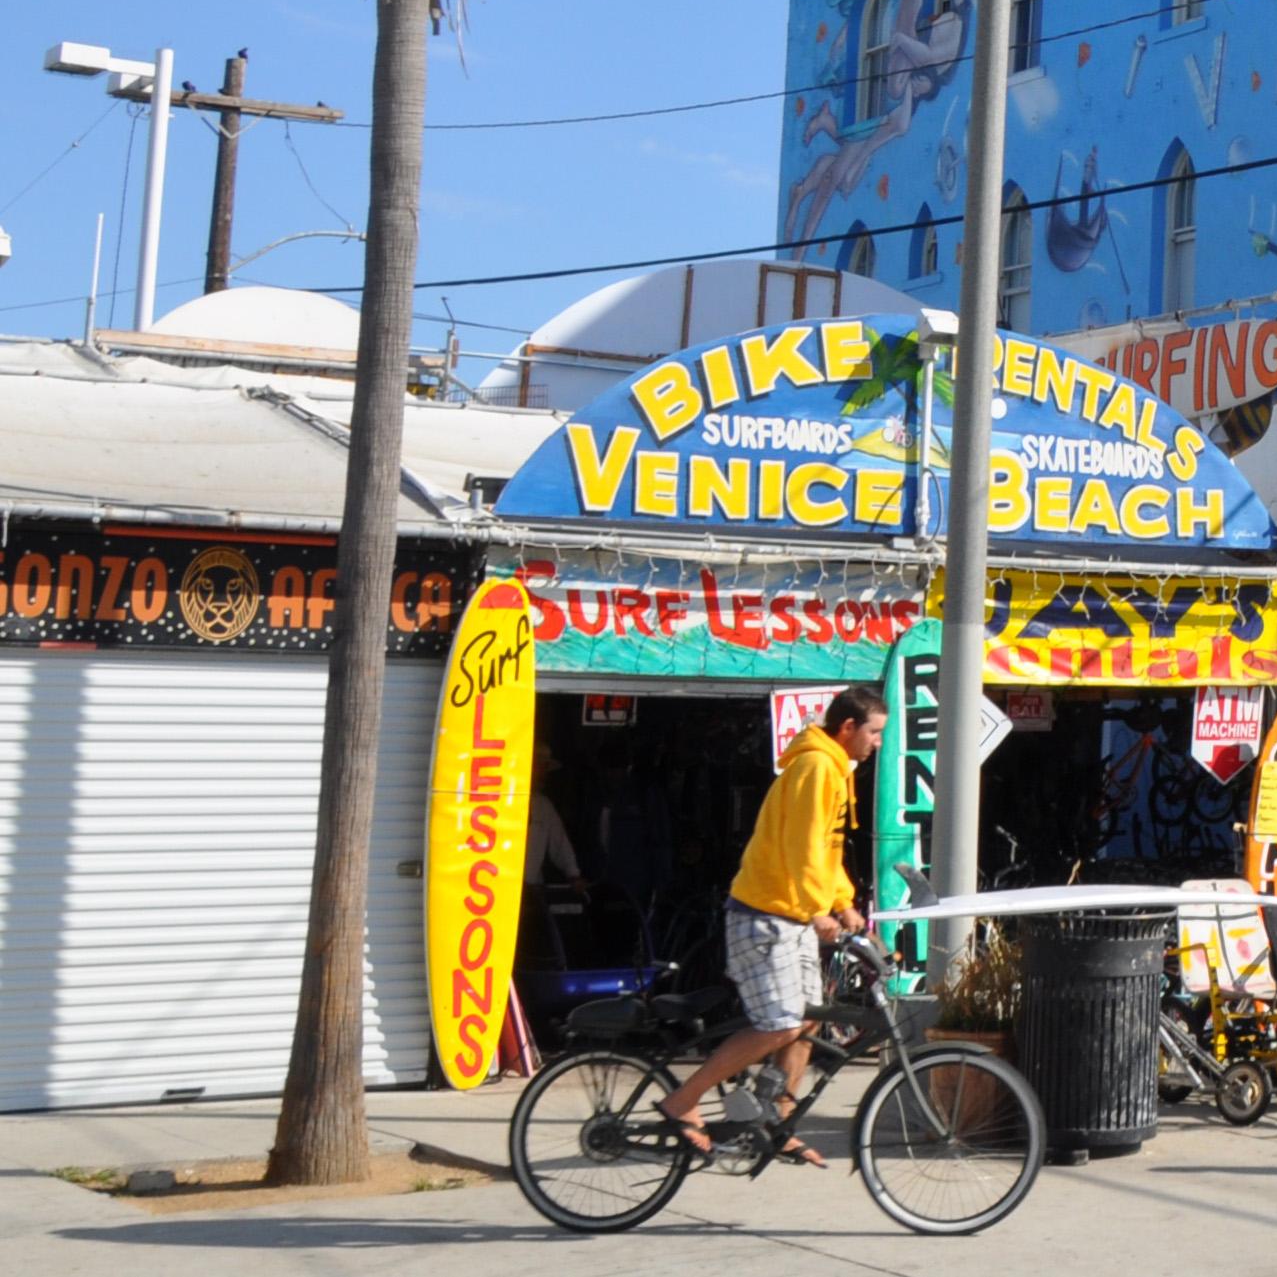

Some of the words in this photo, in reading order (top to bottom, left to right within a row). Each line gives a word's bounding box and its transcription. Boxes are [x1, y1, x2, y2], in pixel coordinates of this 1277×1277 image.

[631, 320, 874, 442] BIKE
[565, 422, 906, 527] VENICE
[988, 448, 1226, 540] BEACH
[701, 413, 853, 455] SURFBOARDS
[1020, 433, 1167, 479] SKATEBOARDS
[0, 551, 168, 623] ONZO
[267, 565, 453, 634] AFCA
[514, 559, 691, 643] SURF
[699, 565, 922, 652] LESSONS
[451, 614, 531, 708] Surf
[1197, 685, 1259, 722] ATM
[1199, 722, 1258, 739] MACHINE
[451, 693, 507, 1079] LESSONS
